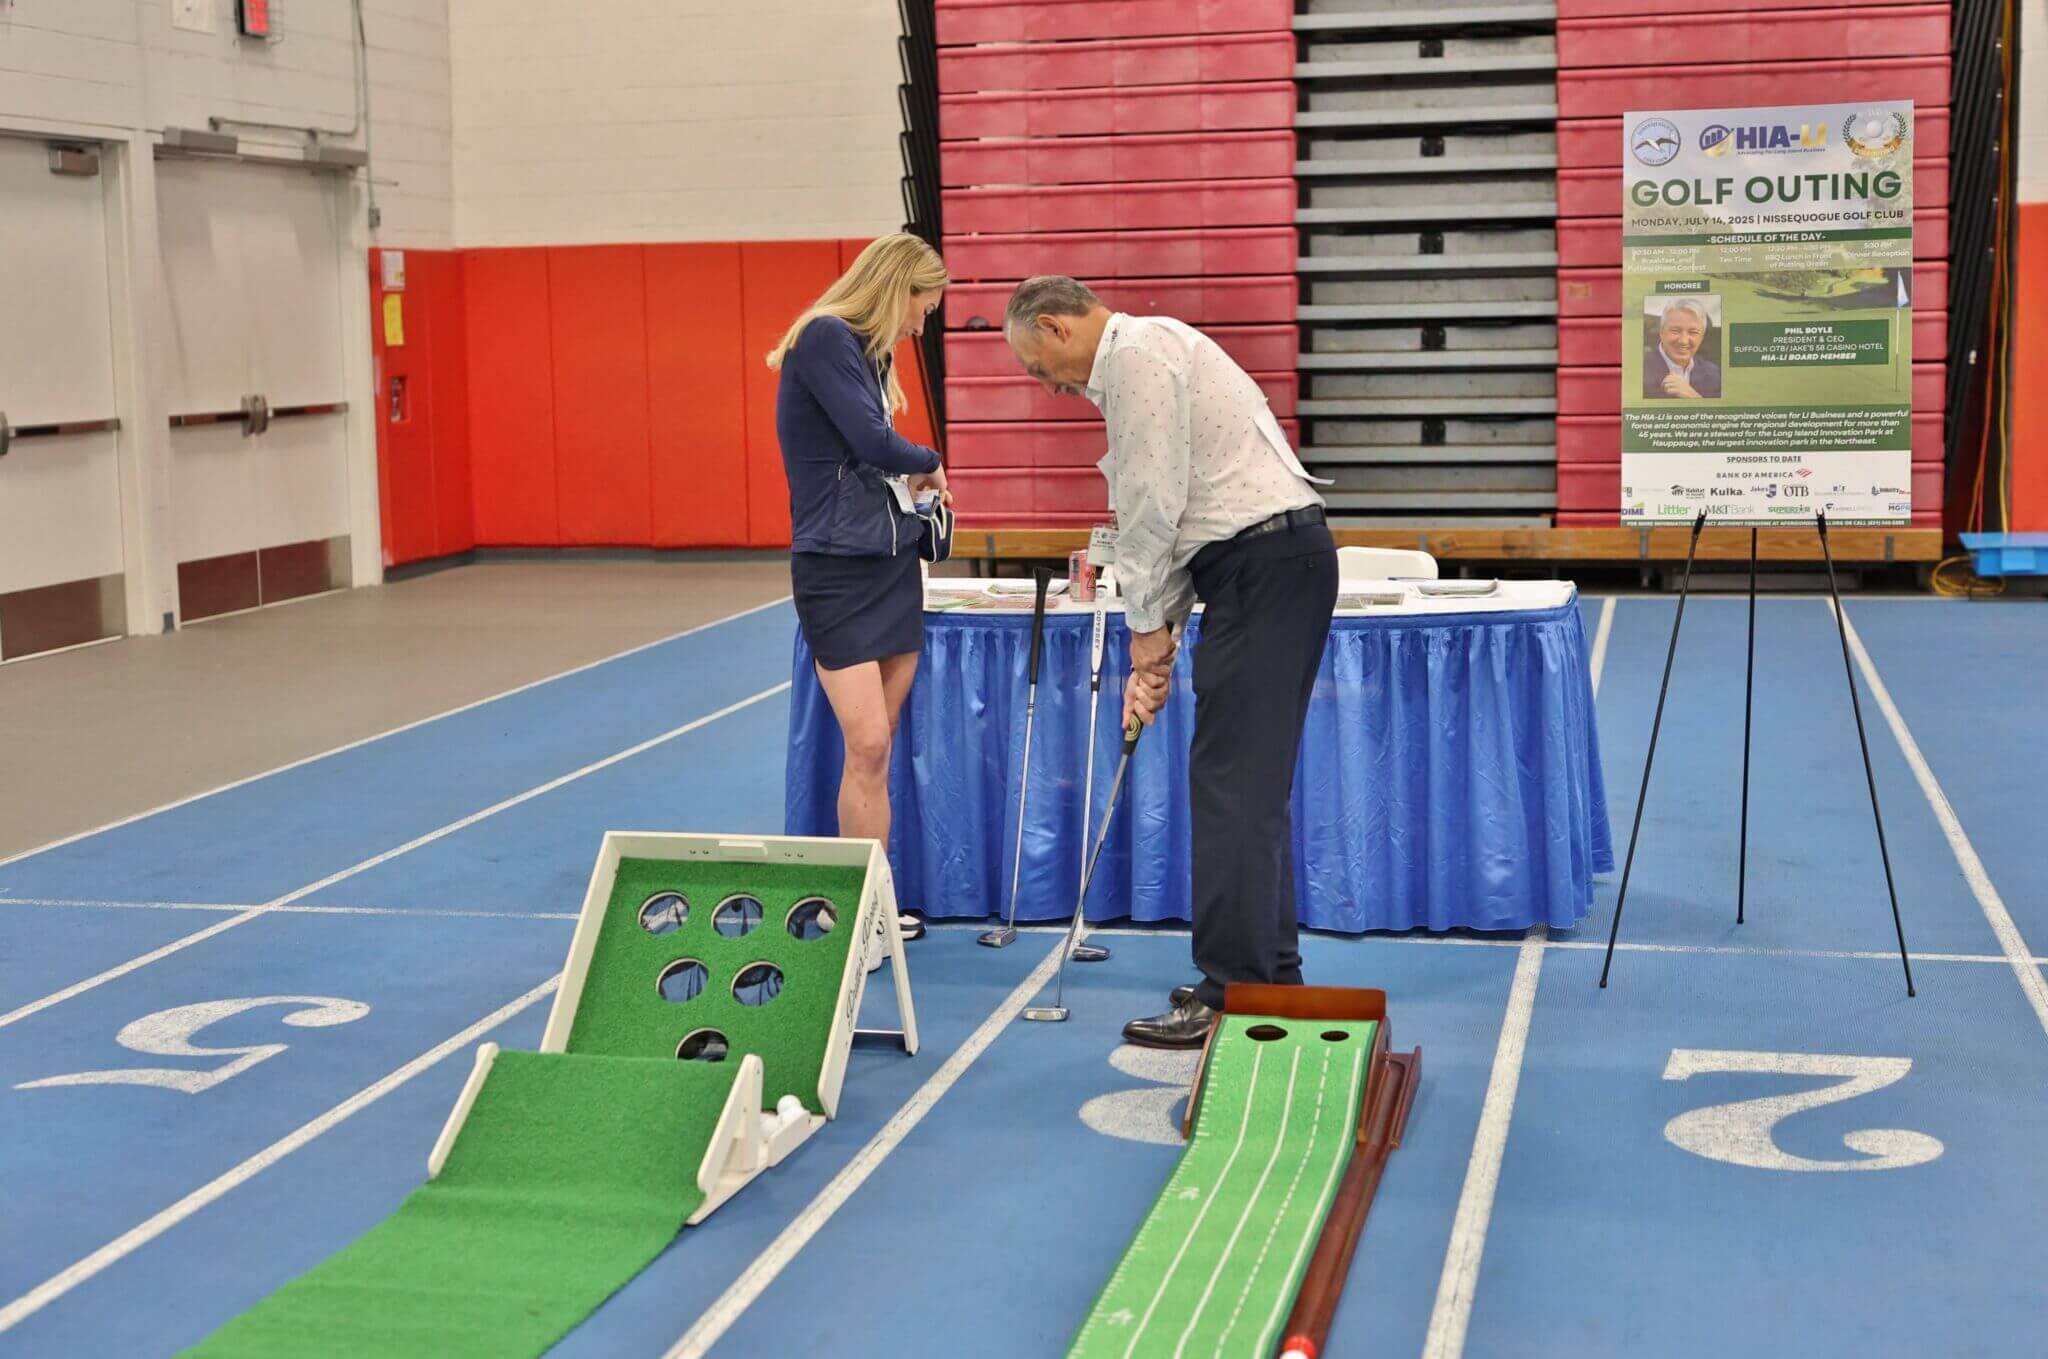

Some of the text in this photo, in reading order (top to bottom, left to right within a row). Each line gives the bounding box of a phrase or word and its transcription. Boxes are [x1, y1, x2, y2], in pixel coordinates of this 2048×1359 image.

[1631, 171, 1902, 207] GOLF OUTING
[1632, 218, 1681, 227] MONDAY,
[1684, 217, 1708, 226] JULY
[1728, 216, 1754, 224] 2025
[1762, 213, 1840, 224] NISSEQUOGUE
[1843, 211, 1872, 220] GOLF
[1874, 210, 1904, 220] CLUB
[1764, 234, 1778, 242] OF
[1780, 233, 1798, 241] THE
[1773, 336, 1817, 344] PRESIDENT
[1858, 342, 1884, 350] HOTEL
[1715, 413, 1760, 422] recognized
[1870, 410, 1909, 419] powerful
[1712, 422, 1739, 430] engine
[1753, 421, 1787, 430] regional
[1788, 420, 1842, 429] development
[1773, 430, 1793, 438] Long
[1784, 486, 1809, 497] OTB
[1094, 609, 1102, 651] ODYSSEY
[1662, 1048, 1945, 1172] 2
